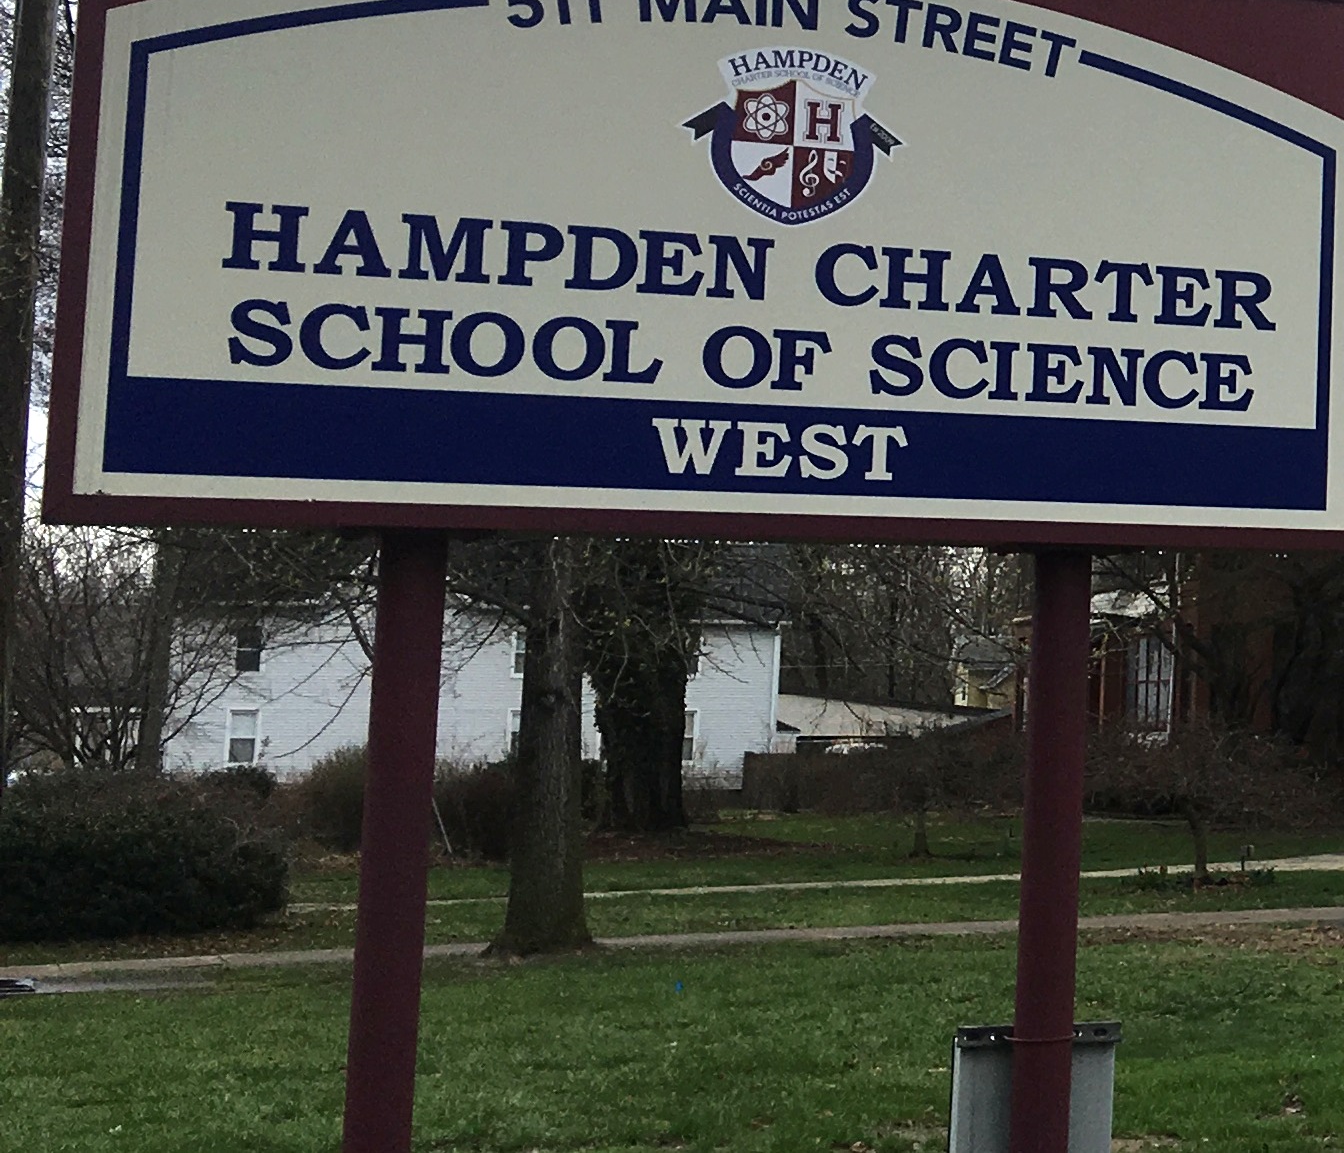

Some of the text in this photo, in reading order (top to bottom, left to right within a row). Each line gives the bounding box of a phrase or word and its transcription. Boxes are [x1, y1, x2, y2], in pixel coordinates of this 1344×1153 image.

[728, 49, 868, 90] HAMPDEN
[731, 70, 773, 87] CHARTER
[773, 69, 811, 80] SCHOOL
[812, 72, 824, 81] OF
[804, 100, 844, 144] H
[733, 183, 852, 221] SCIENTIA POTESTAS EST
[221, 200, 1277, 332] HAMPDEN CHARTER
[228, 298, 1256, 413] SCHOOL OF SCIENCE
[651, 417, 909, 482] WEST
